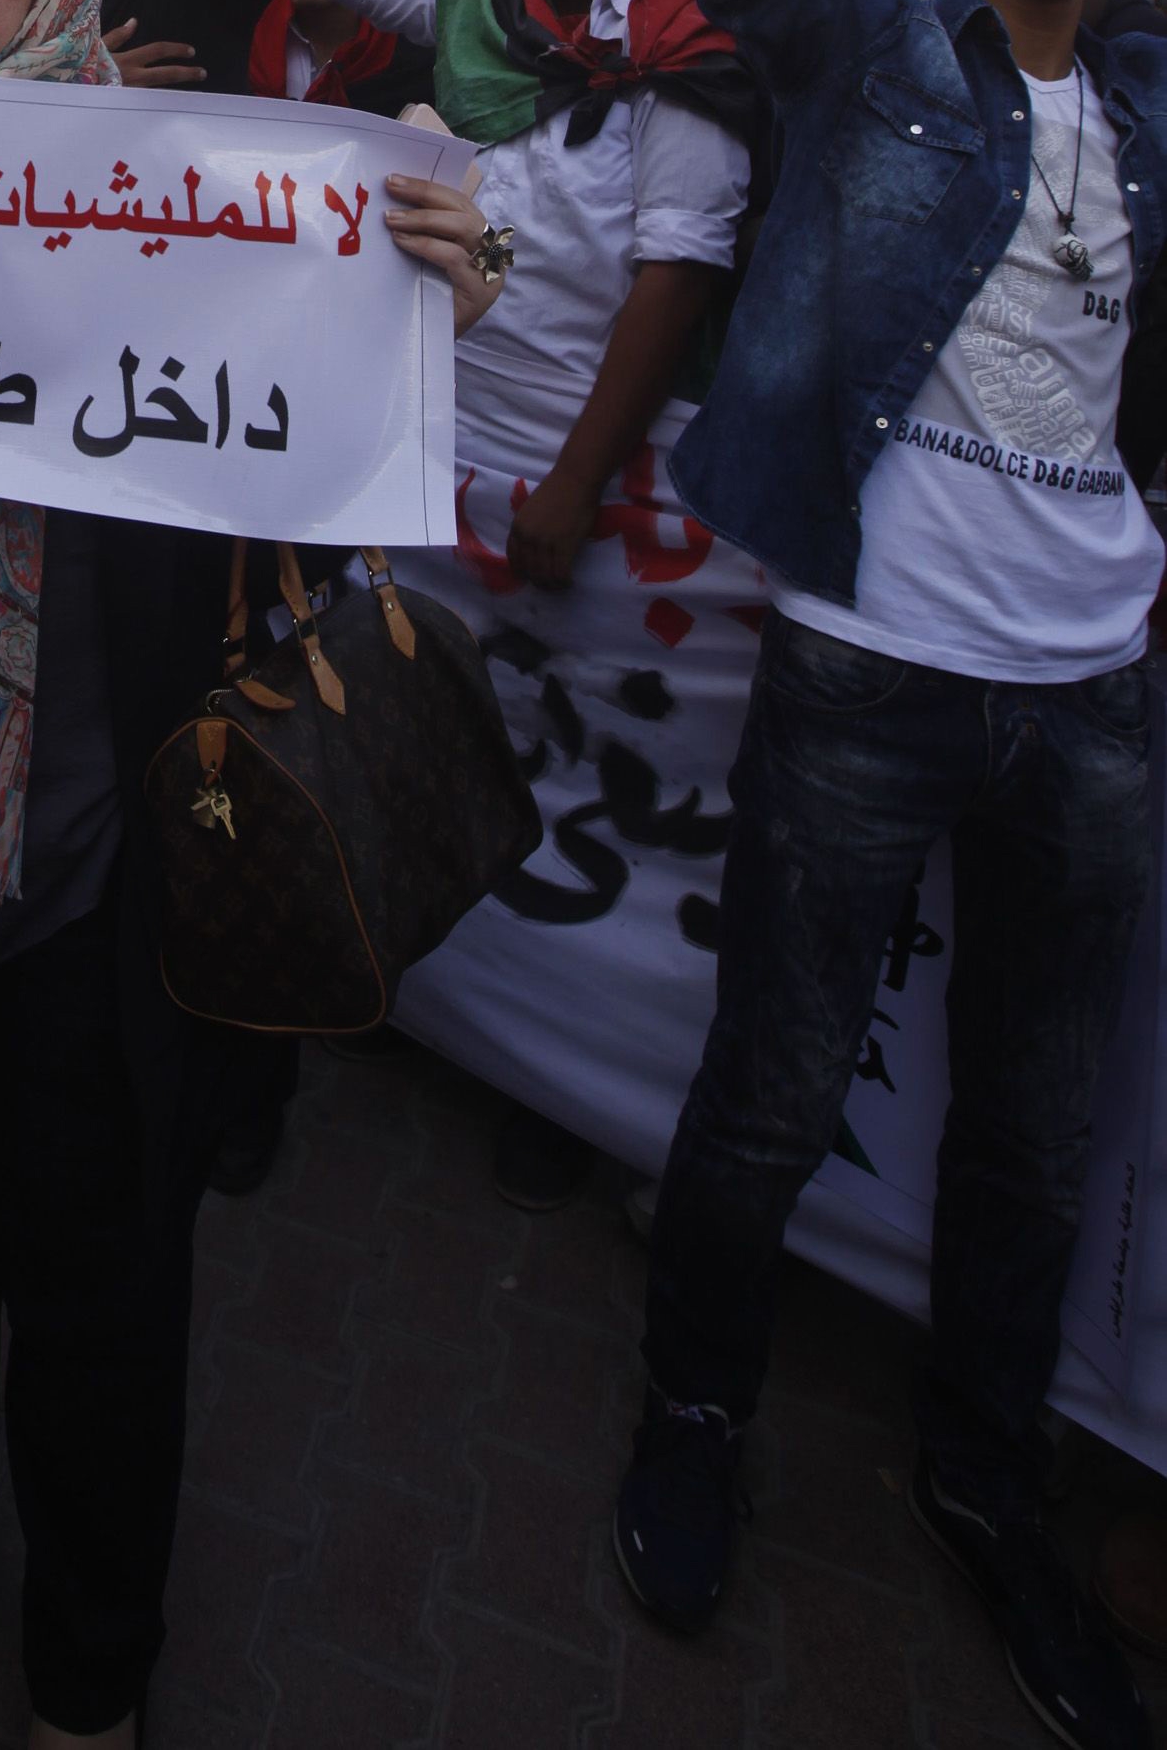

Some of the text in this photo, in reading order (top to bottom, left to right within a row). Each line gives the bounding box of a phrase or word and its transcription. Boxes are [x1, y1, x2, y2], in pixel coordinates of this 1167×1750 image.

[323, 182, 369, 257] لا
[1082, 290, 1122, 324] D&G
[71, 343, 289, 459] داخل
[1033, 458, 1075, 491] D&G
